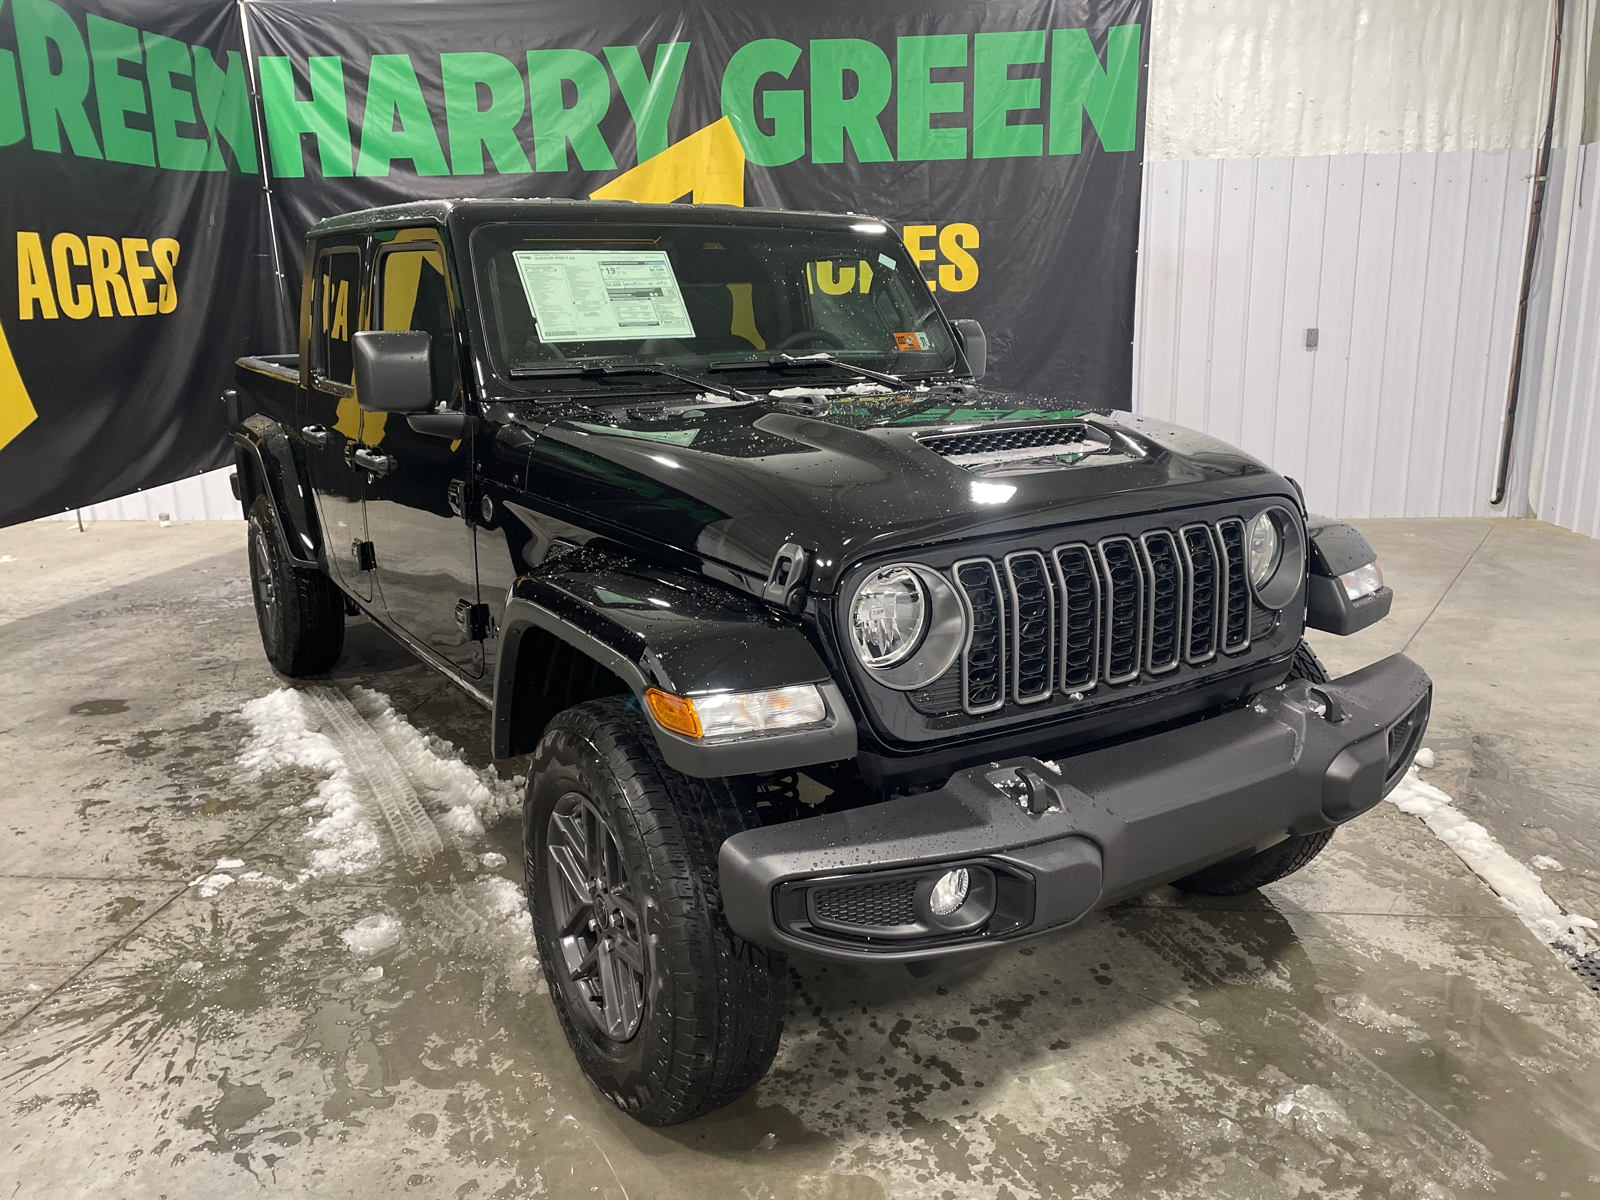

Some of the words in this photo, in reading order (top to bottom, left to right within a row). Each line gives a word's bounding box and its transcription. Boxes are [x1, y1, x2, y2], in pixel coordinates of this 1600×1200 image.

[258, 42, 691, 178] HARRY
[720, 24, 1141, 167] GREEN
[17, 231, 180, 320] ACRES
[605, 267, 616, 275] 19
